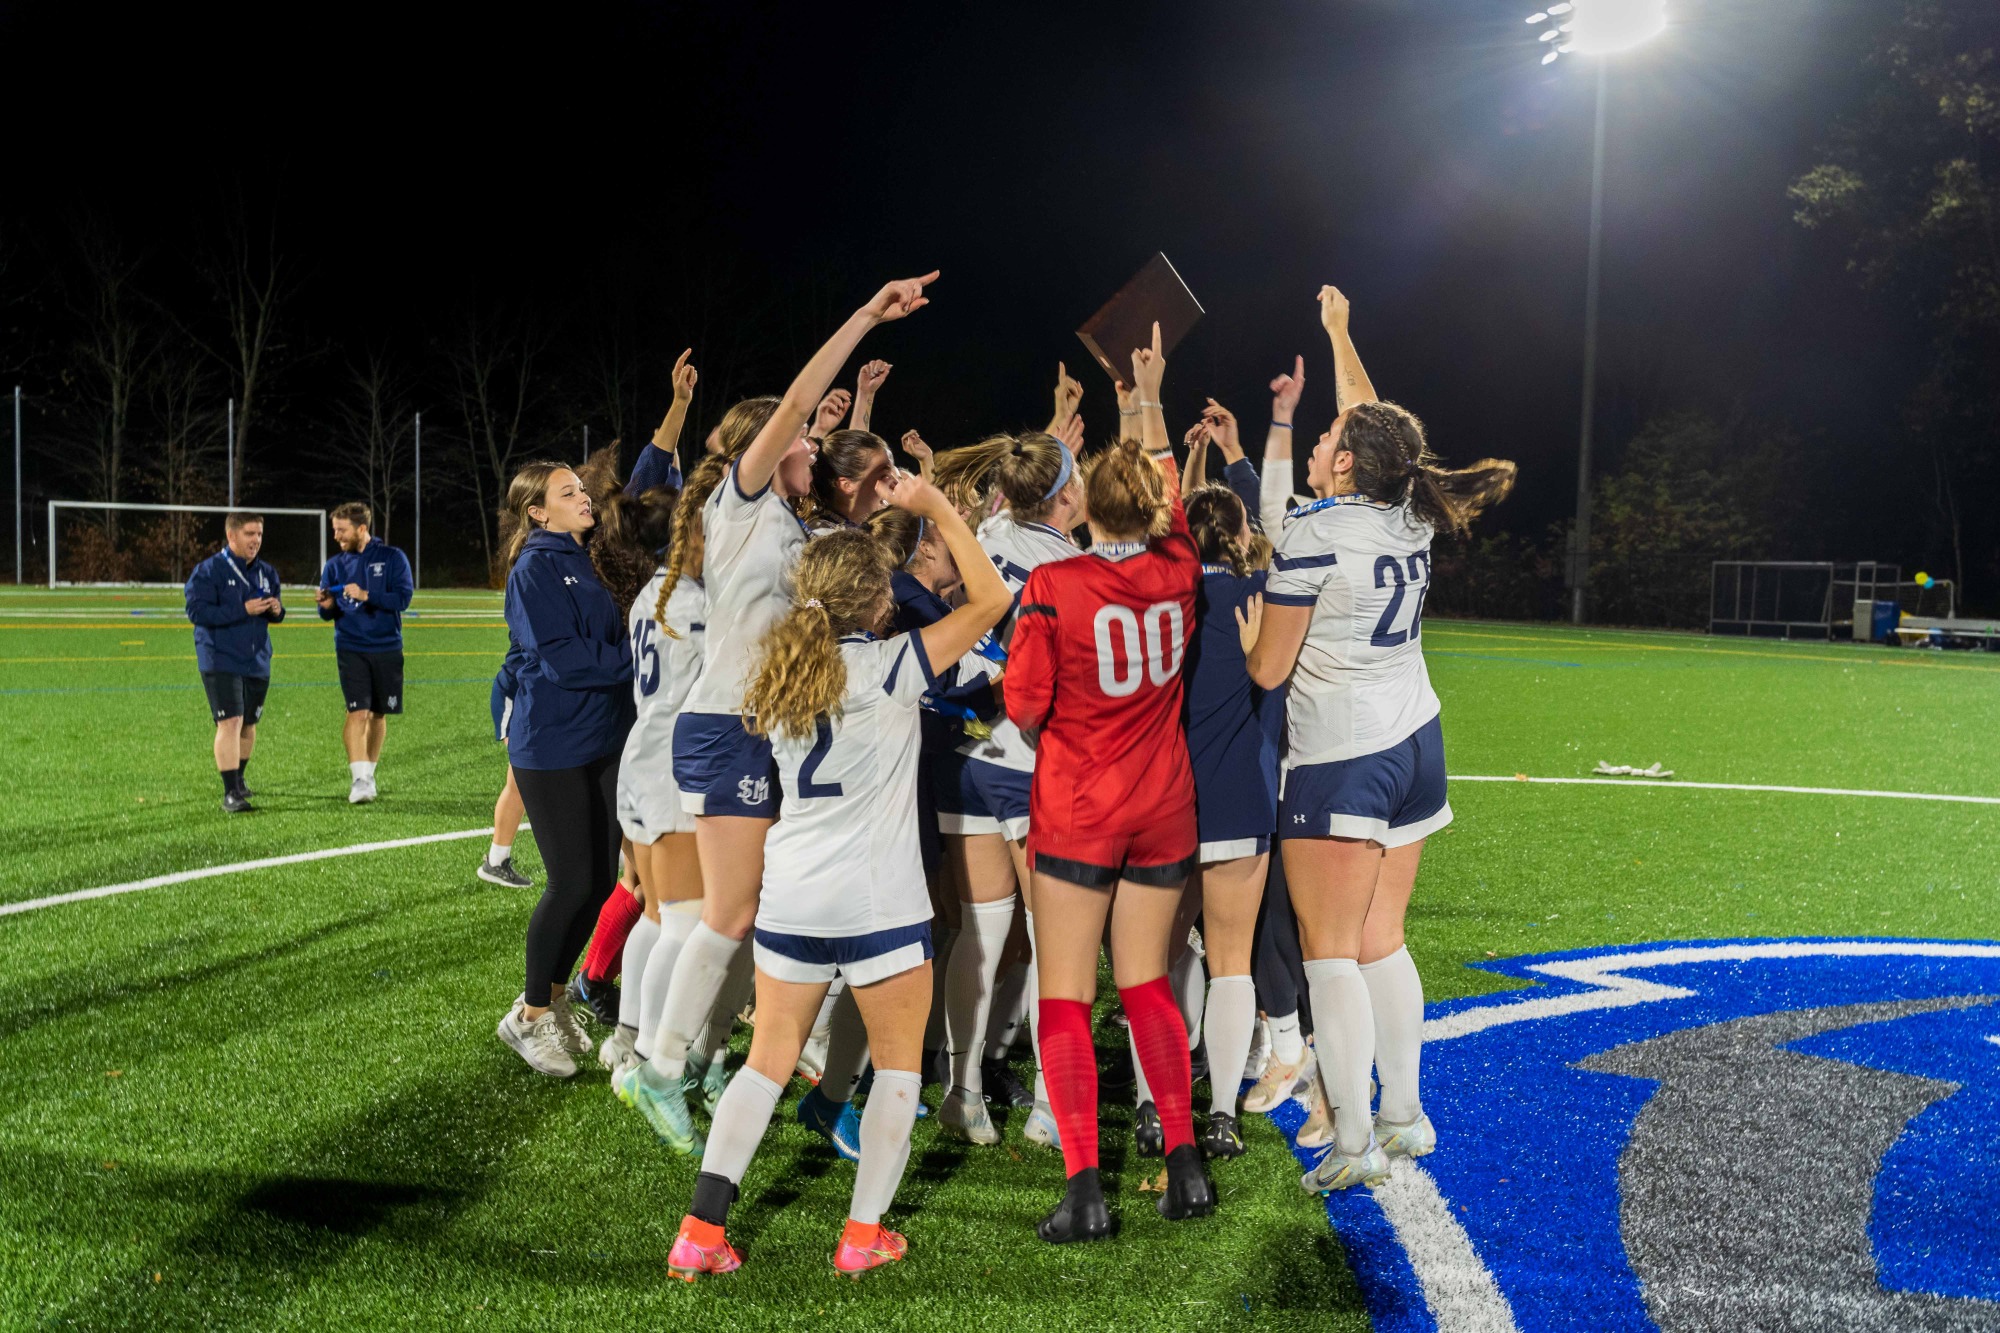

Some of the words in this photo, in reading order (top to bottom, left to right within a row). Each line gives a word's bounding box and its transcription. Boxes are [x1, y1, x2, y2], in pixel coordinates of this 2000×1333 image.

[633, 619, 660, 697] 15
[1093, 601, 1184, 698] 00
[797, 709, 844, 799] 2
